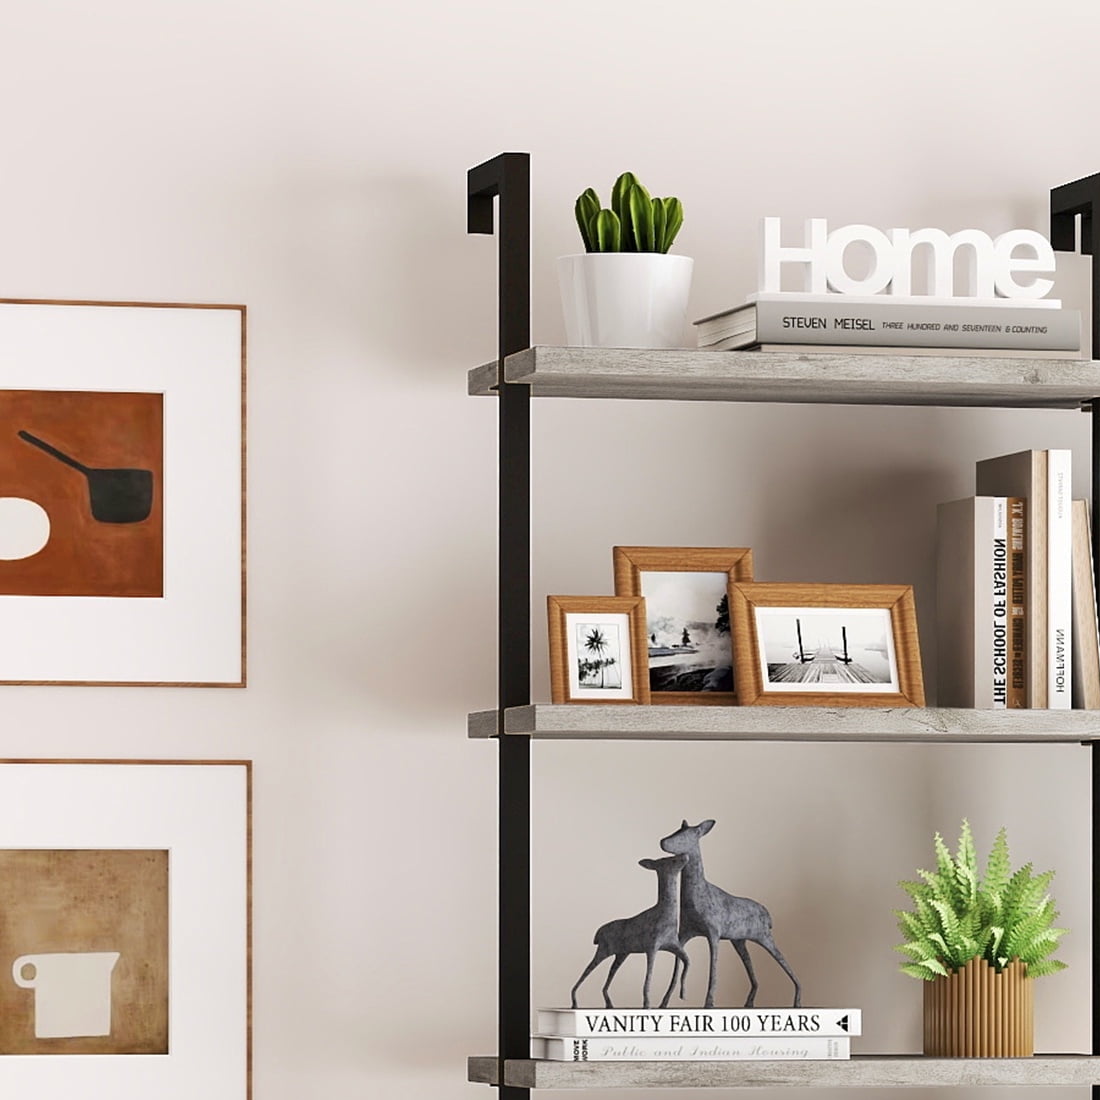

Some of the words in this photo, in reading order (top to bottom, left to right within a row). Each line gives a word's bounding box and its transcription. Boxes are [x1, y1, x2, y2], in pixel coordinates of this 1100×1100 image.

[761, 216, 1056, 299] Home
[783, 317, 826, 329] STEVEN
[835, 319, 875, 330] MEISEL
[882, 322, 904, 330] THREE
[907, 323, 940, 331] HUNDRED
[944, 324, 959, 332] AND
[961, 324, 1001, 333] SEVENTEEN
[586, 1015, 662, 1032] VANITY
[671, 1015, 714, 1032] FAIR
[723, 1016, 750, 1032] 100
[757, 1015, 820, 1031] YEARS
[601, 1045, 647, 1057] Public
[654, 1046, 682, 1056] and
[690, 1045, 740, 1056] Indian
[748, 1045, 808, 1058] Housing
